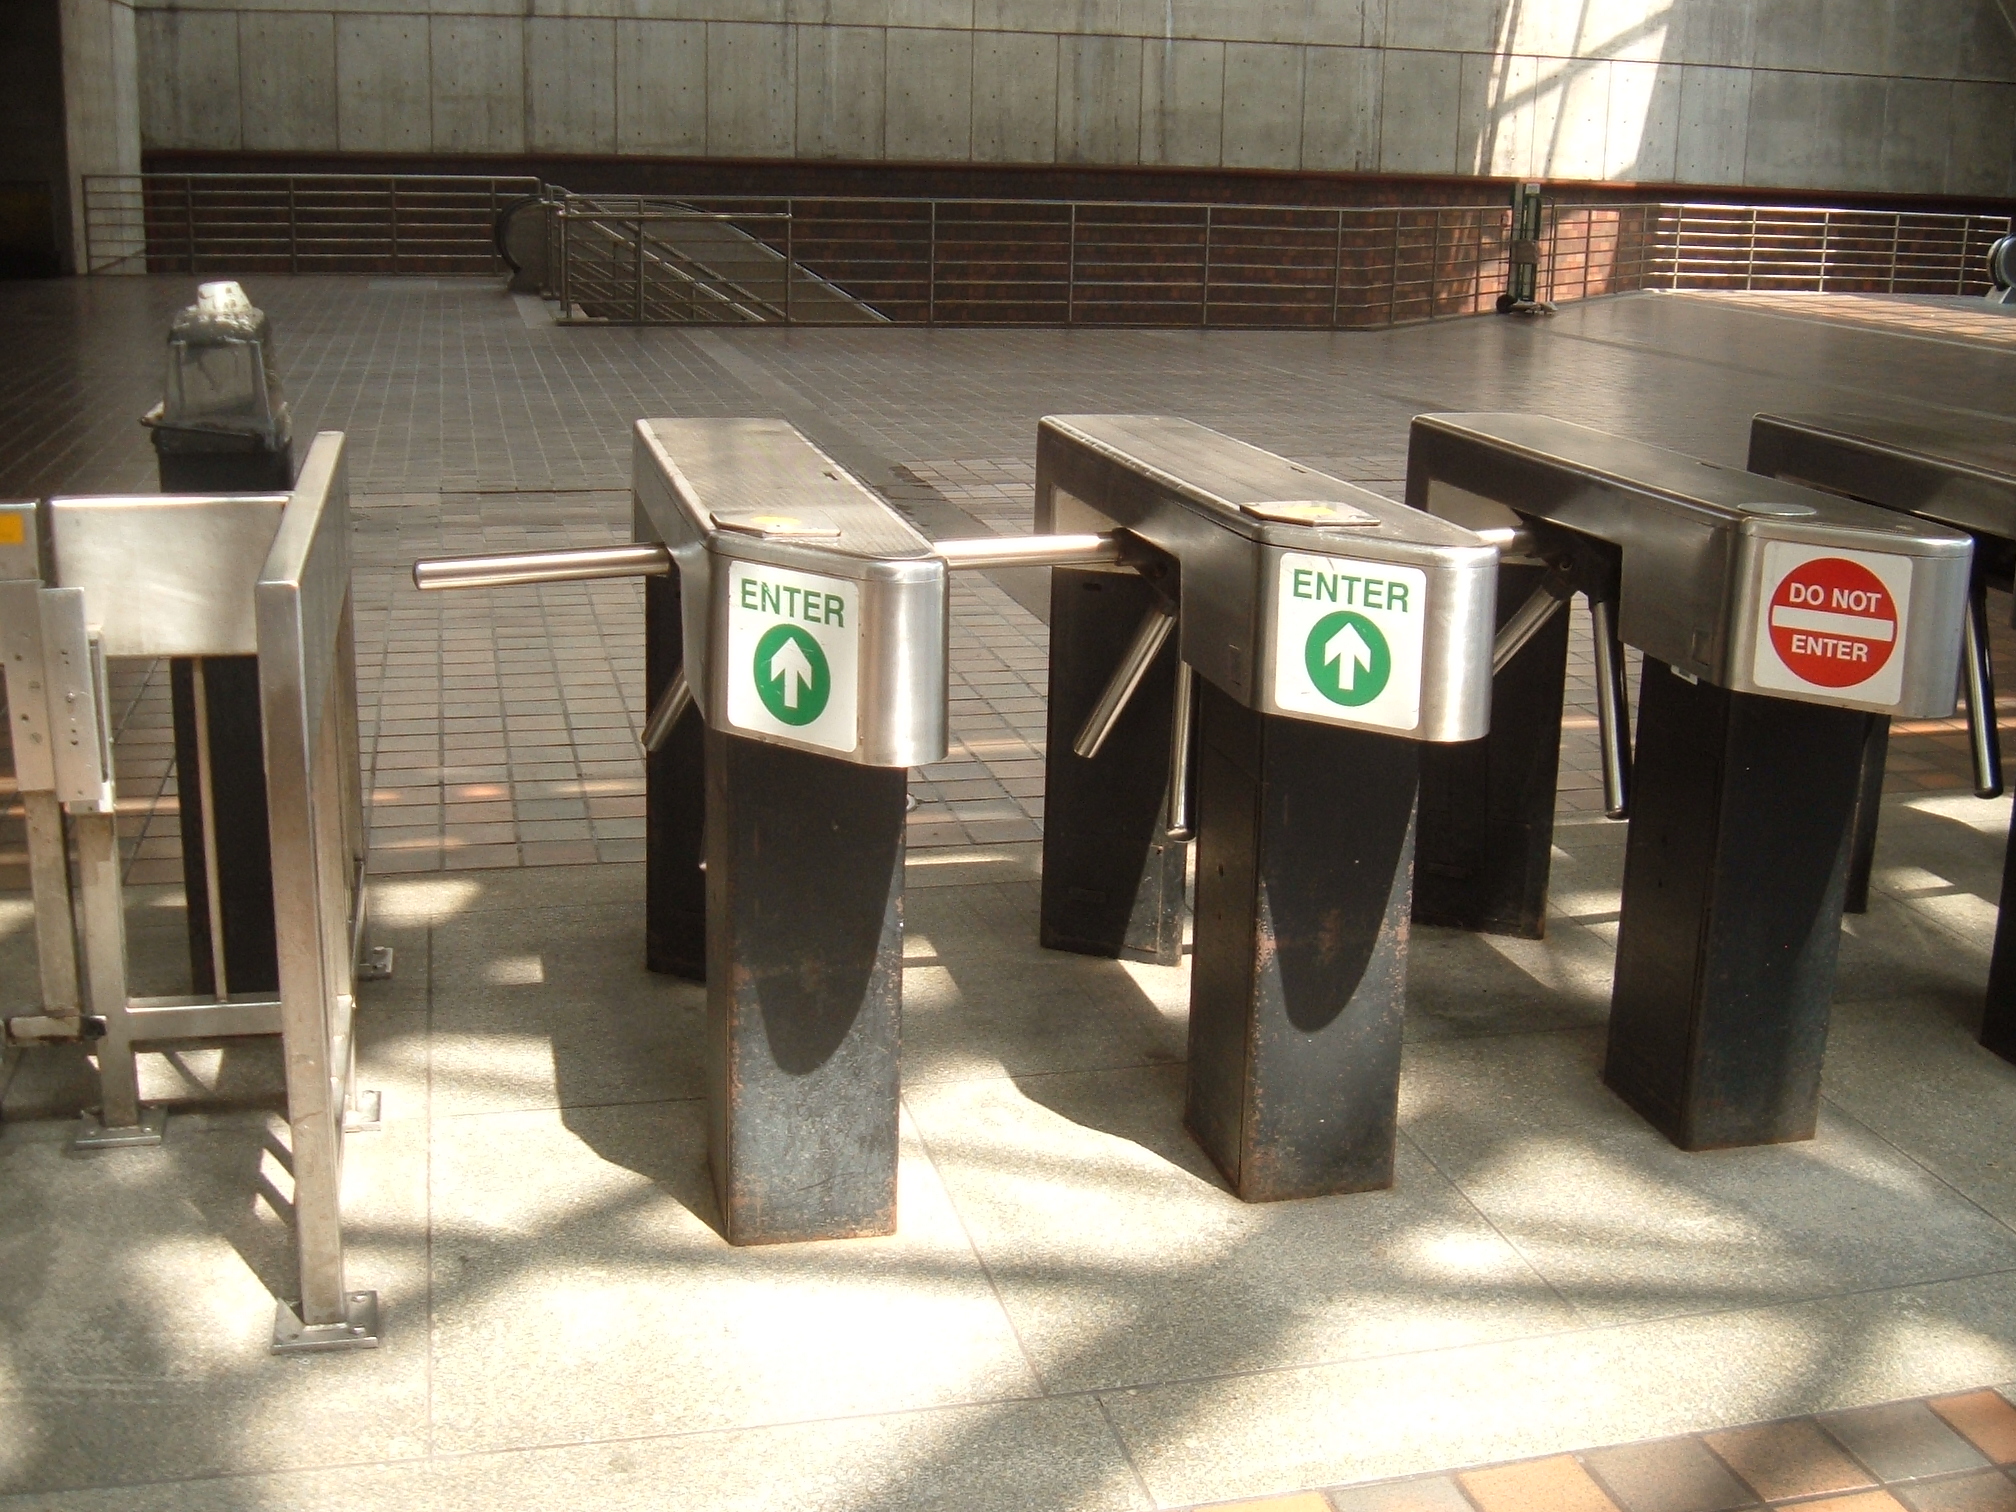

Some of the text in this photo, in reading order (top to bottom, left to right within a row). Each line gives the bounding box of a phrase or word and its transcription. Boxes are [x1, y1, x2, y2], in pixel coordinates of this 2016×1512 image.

[741, 578, 845, 628] ENTER
[1293, 568, 1409, 613] ENTER
[1789, 582, 1882, 613] DO NOT
[1791, 634, 1868, 662] ENTER
